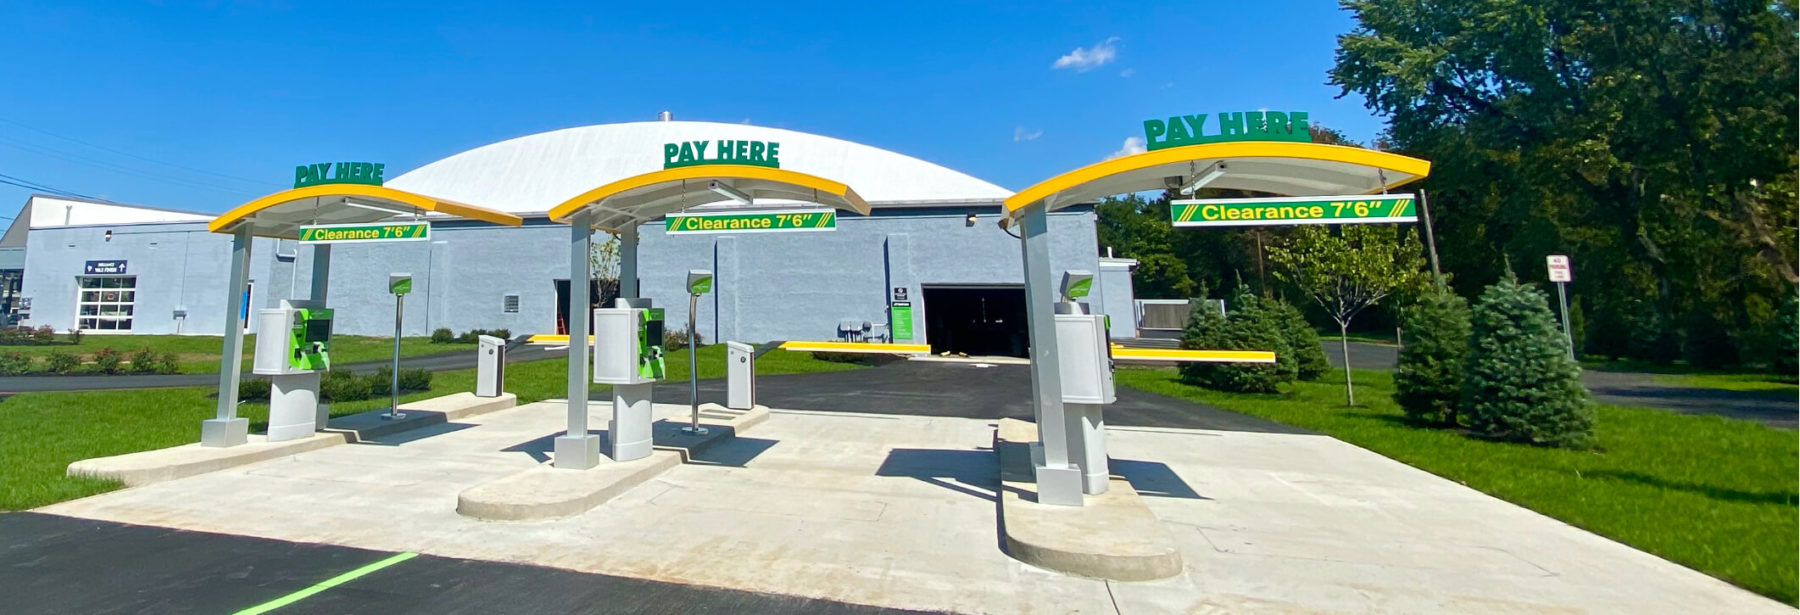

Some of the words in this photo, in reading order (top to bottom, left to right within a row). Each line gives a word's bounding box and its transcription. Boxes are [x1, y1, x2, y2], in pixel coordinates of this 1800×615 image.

[1144, 114, 1207, 144] PAY
[1219, 111, 1310, 140] HERE
[664, 141, 709, 164] PAY
[716, 140, 780, 163] HERE
[295, 163, 332, 184] PAY
[335, 162, 385, 184] HERE
[1201, 204, 1324, 221] Clearance
[1330, 200, 1382, 218] 7'6"
[685, 216, 771, 230] Clearance
[776, 213, 813, 228] 7'6"
[314, 228, 380, 240] Clearance
